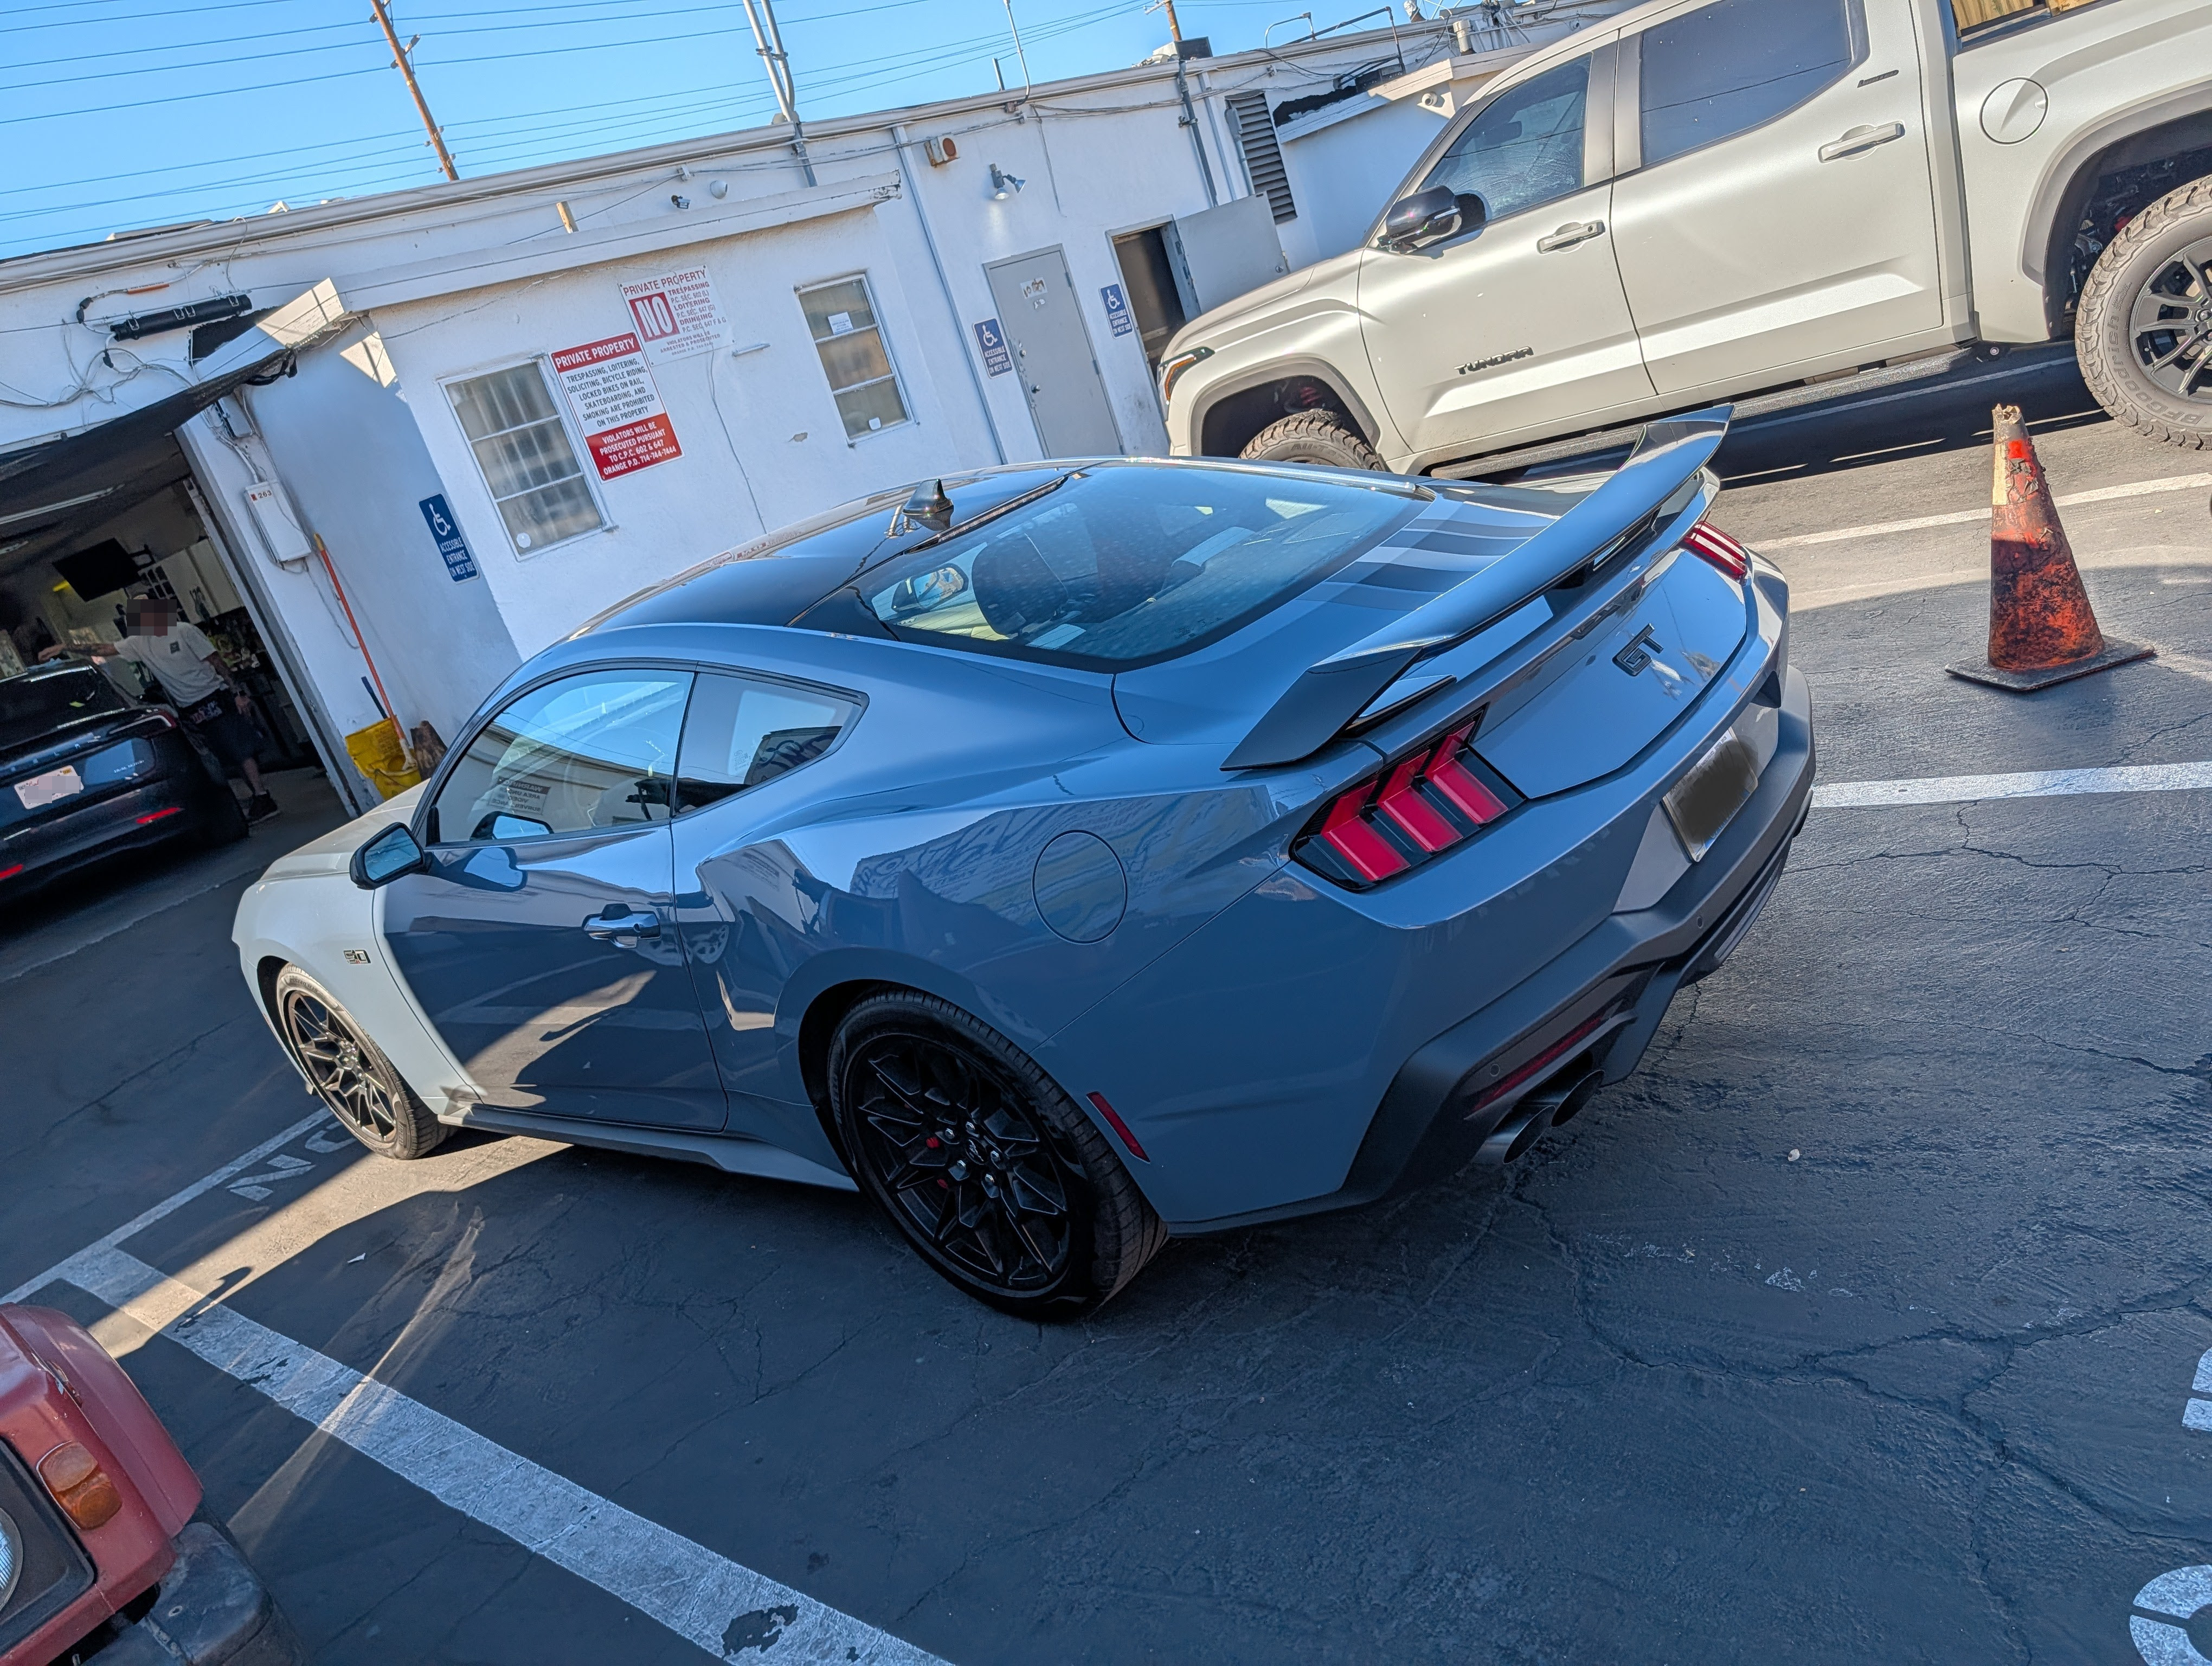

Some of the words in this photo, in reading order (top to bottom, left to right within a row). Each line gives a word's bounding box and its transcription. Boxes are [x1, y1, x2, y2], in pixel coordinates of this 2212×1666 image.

[623, 280, 660, 297] PRIVATE
[661, 269, 706, 288] PROPERTY
[667, 281, 710, 296] TRESPASSING
[673, 297, 710, 311] LOITERING
[635, 296, 673, 337] NO
[679, 312, 712, 325] DRINKING
[660, 343, 685, 353] ARRESTED
[690, 334, 721, 345] PROSECUTED
[667, 335, 692, 345] VIOLATORS
[555, 348, 592, 369] PRIVATE
[592, 337, 635, 359] PROPERTY
[1454, 345, 1534, 375] TUNDRA
[567, 367, 608, 383] TRESPASSING,
[608, 358, 640, 372] LOITERING,
[567, 378, 602, 394] SOLICITING,
[602, 373, 626, 388] BICYCLE
[627, 366, 648, 379] RIDING,
[578, 388, 602, 401] LOCKED
[603, 383, 620, 395] BIKES
[620, 381, 628, 389] ON
[629, 377, 645, 387] RAIL,
[584, 393, 634, 410] SKATEBOARDING,
[634, 386, 646, 396] AND
[582, 407, 610, 421] SMOKING
[610, 403, 622, 413] ARE
[623, 394, 655, 411] PROHIBITED
[596, 418, 606, 427] ON
[606, 414, 620, 425] THIS
[621, 406, 649, 422] PROPERTY
[599, 438, 636, 456] PROSECUTED
[637, 428, 666, 444] PURSUANT
[602, 427, 634, 444] VIOLATORS
[635, 423, 649, 435] WILL
[649, 421, 657, 430] BE
[603, 460, 628, 476] ORANGE
[628, 456, 640, 469] P.D.
[640, 445, 677, 463] 714-744-7444
[608, 454, 618, 464] TO
[619, 448, 635, 460] C.P.C.
[636, 445, 648, 454] 602
[649, 443, 654, 451] &
[653, 439, 664, 449] 647
[258, 490, 272, 499] 263
[439, 537, 464, 553] ACCESSIBLE
[446, 549, 467, 565] ENTRANCE
[1612, 623, 1664, 677] GT
